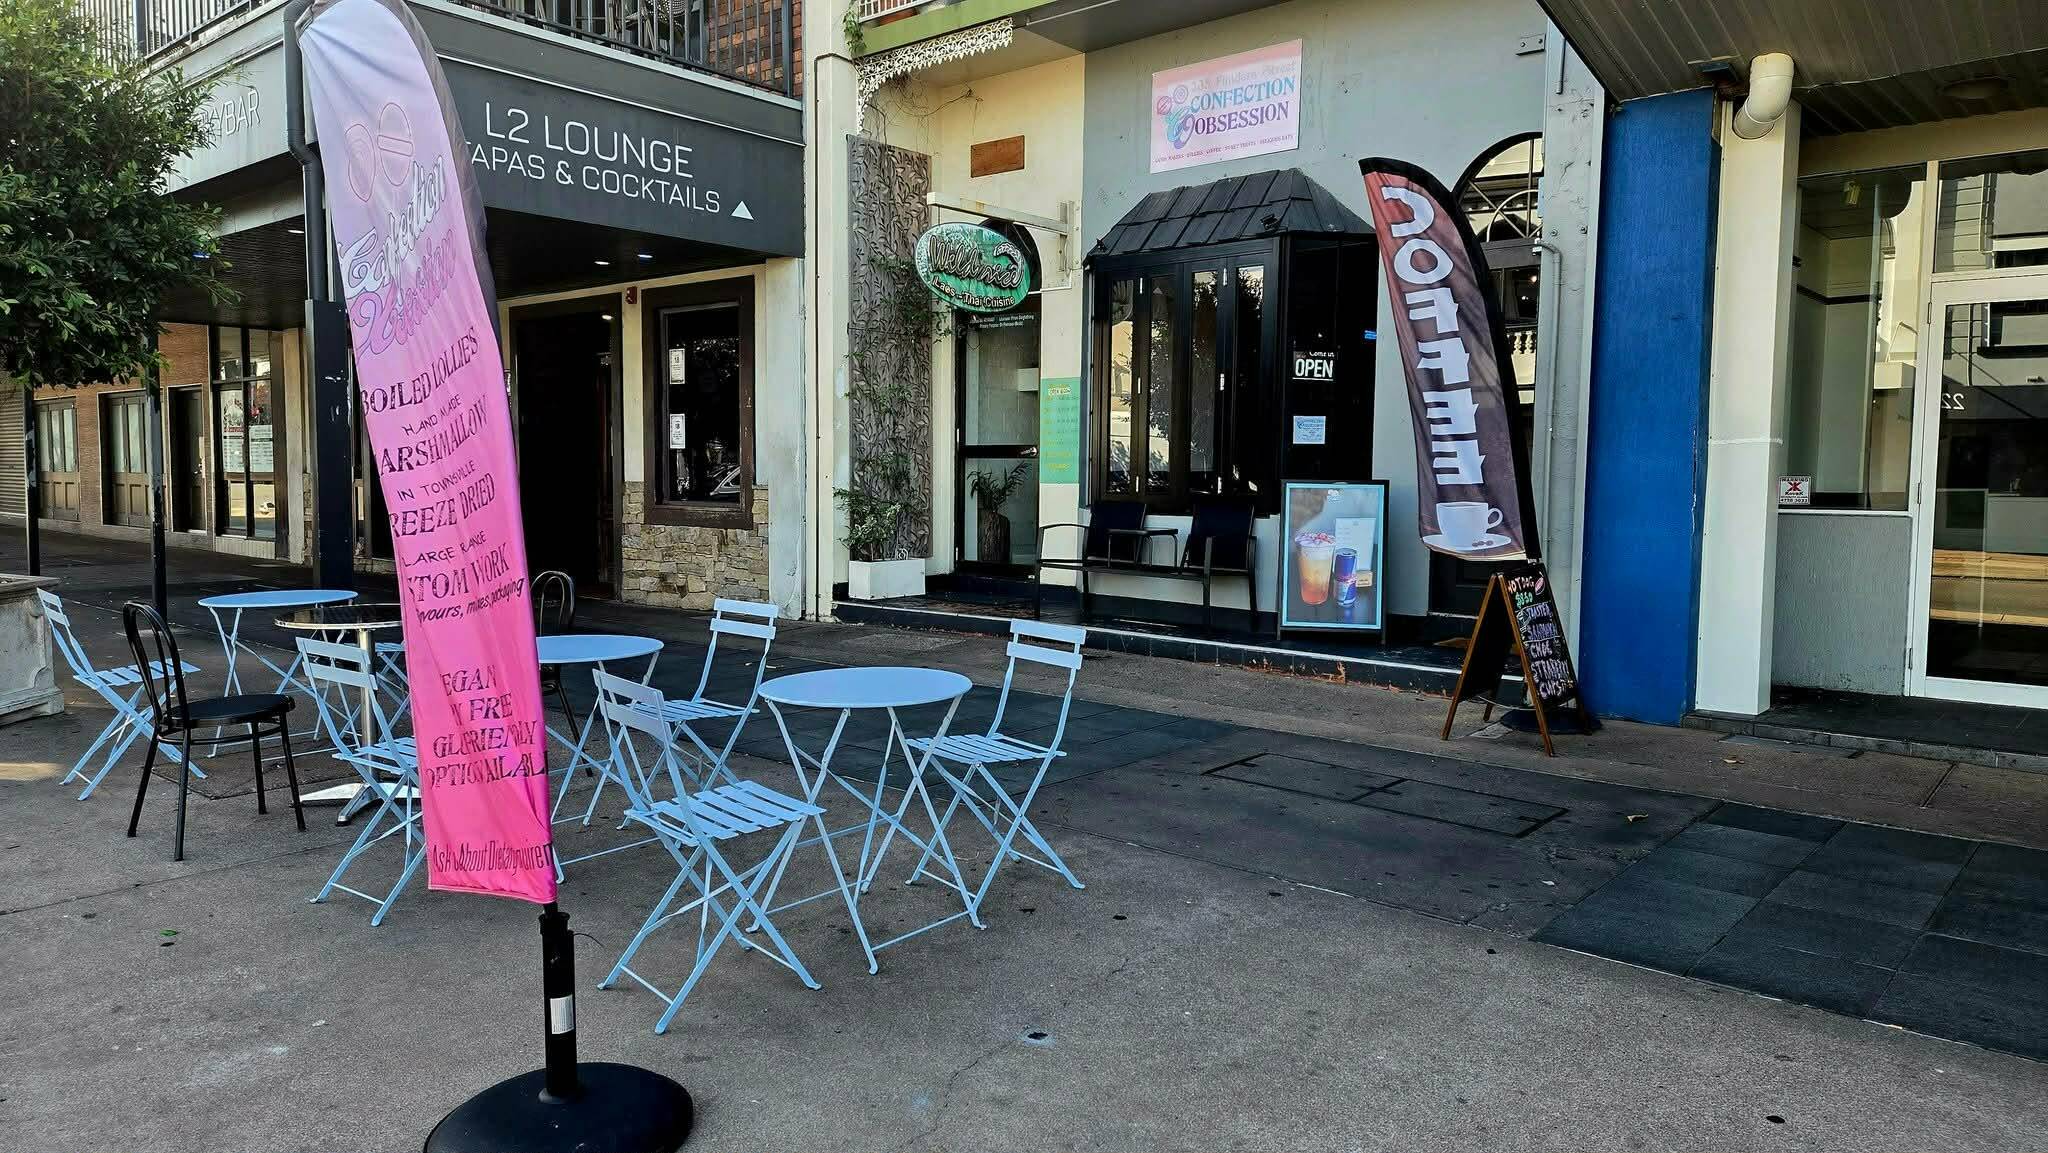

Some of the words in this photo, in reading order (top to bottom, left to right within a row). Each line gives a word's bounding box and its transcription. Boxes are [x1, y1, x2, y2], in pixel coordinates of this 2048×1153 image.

[1191, 76, 1296, 113] CONFECTION
[1194, 101, 1290, 136] OBSESSION
[486, 102, 530, 144] L2
[544, 115, 694, 178] LOUNGE
[464, 139, 545, 180] APAS
[555, 161, 574, 185] &
[582, 166, 720, 213] COCKTAILS
[963, 291, 983, 308] Thai
[984, 295, 1015, 308] Cuisine
[360, 372, 432, 416] BOILED
[431, 325, 480, 390] LOLLIES
[1295, 358, 1334, 378] OPEN
[402, 413, 438, 436] HAND
[440, 393, 461, 419] MADE
[380, 394, 488, 477] ARSHMALLOW
[397, 488, 415, 501] IN
[420, 460, 476, 495] TOWNSVILLE
[388, 498, 458, 538] REEZE
[459, 472, 496, 520] DRIED
[402, 546, 455, 568] LARGE
[459, 530, 487, 554] RANGE
[471, 542, 511, 586] WORK
[440, 664, 497, 697] EGAN
[432, 844, 451, 873] Ask
[459, 842, 487, 873] About
